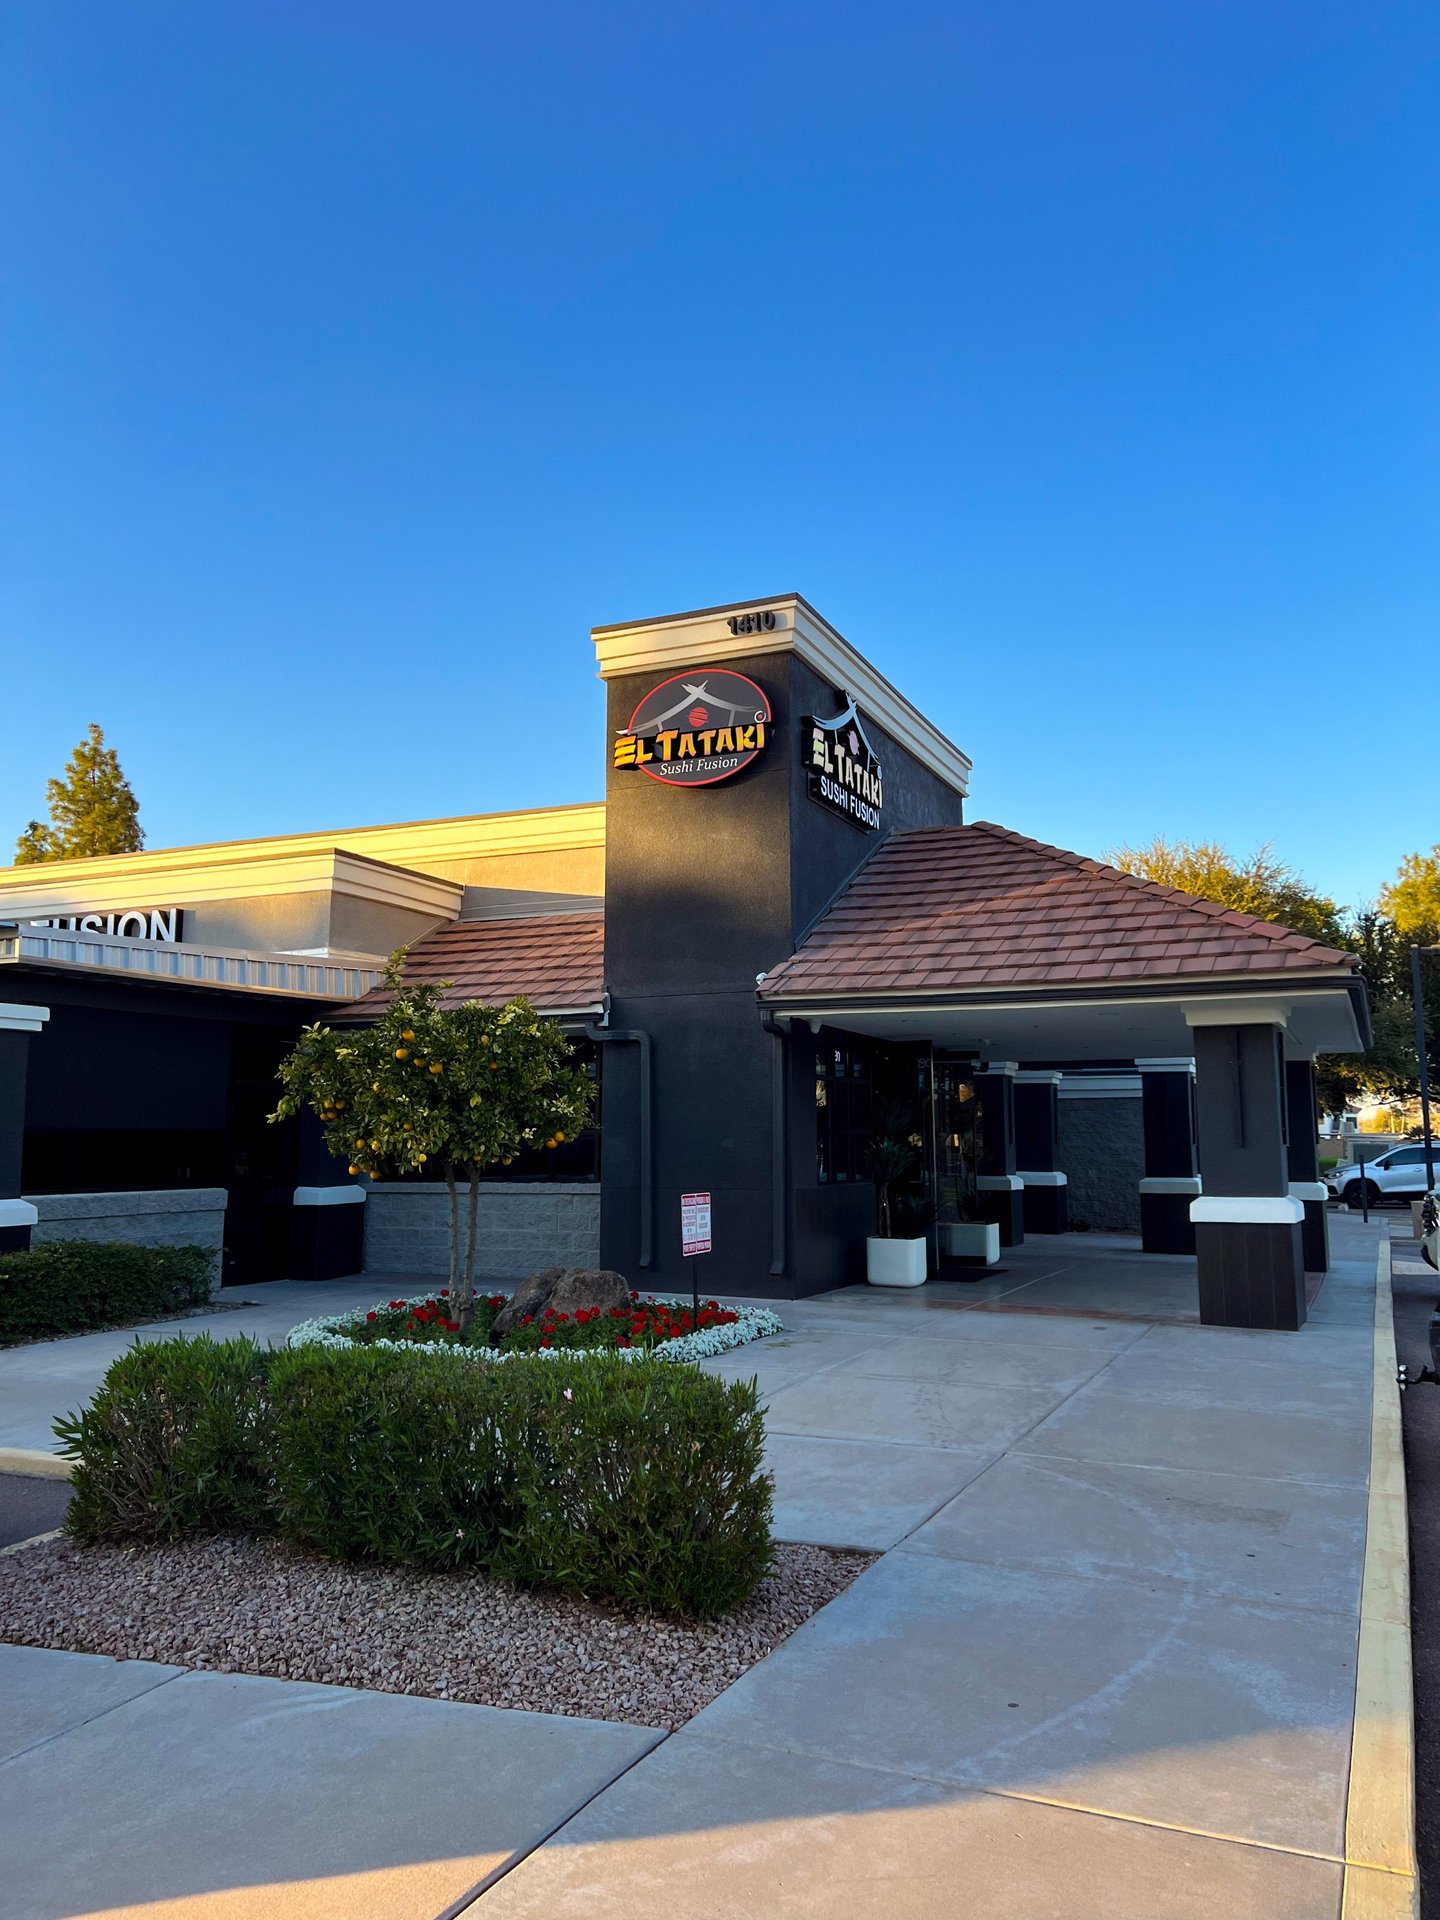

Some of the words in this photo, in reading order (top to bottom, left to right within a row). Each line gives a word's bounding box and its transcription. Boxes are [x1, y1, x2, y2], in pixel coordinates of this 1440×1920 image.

[727, 611, 775, 635] 1410
[613, 735, 653, 768] EL
[659, 759, 694, 776] Sushi
[696, 756, 738, 772] Fusion
[812, 727, 834, 774] EL
[834, 743, 882, 809] TATAKI
[820, 775, 848, 810] SUSHI
[850, 794, 880, 830] FUSION
